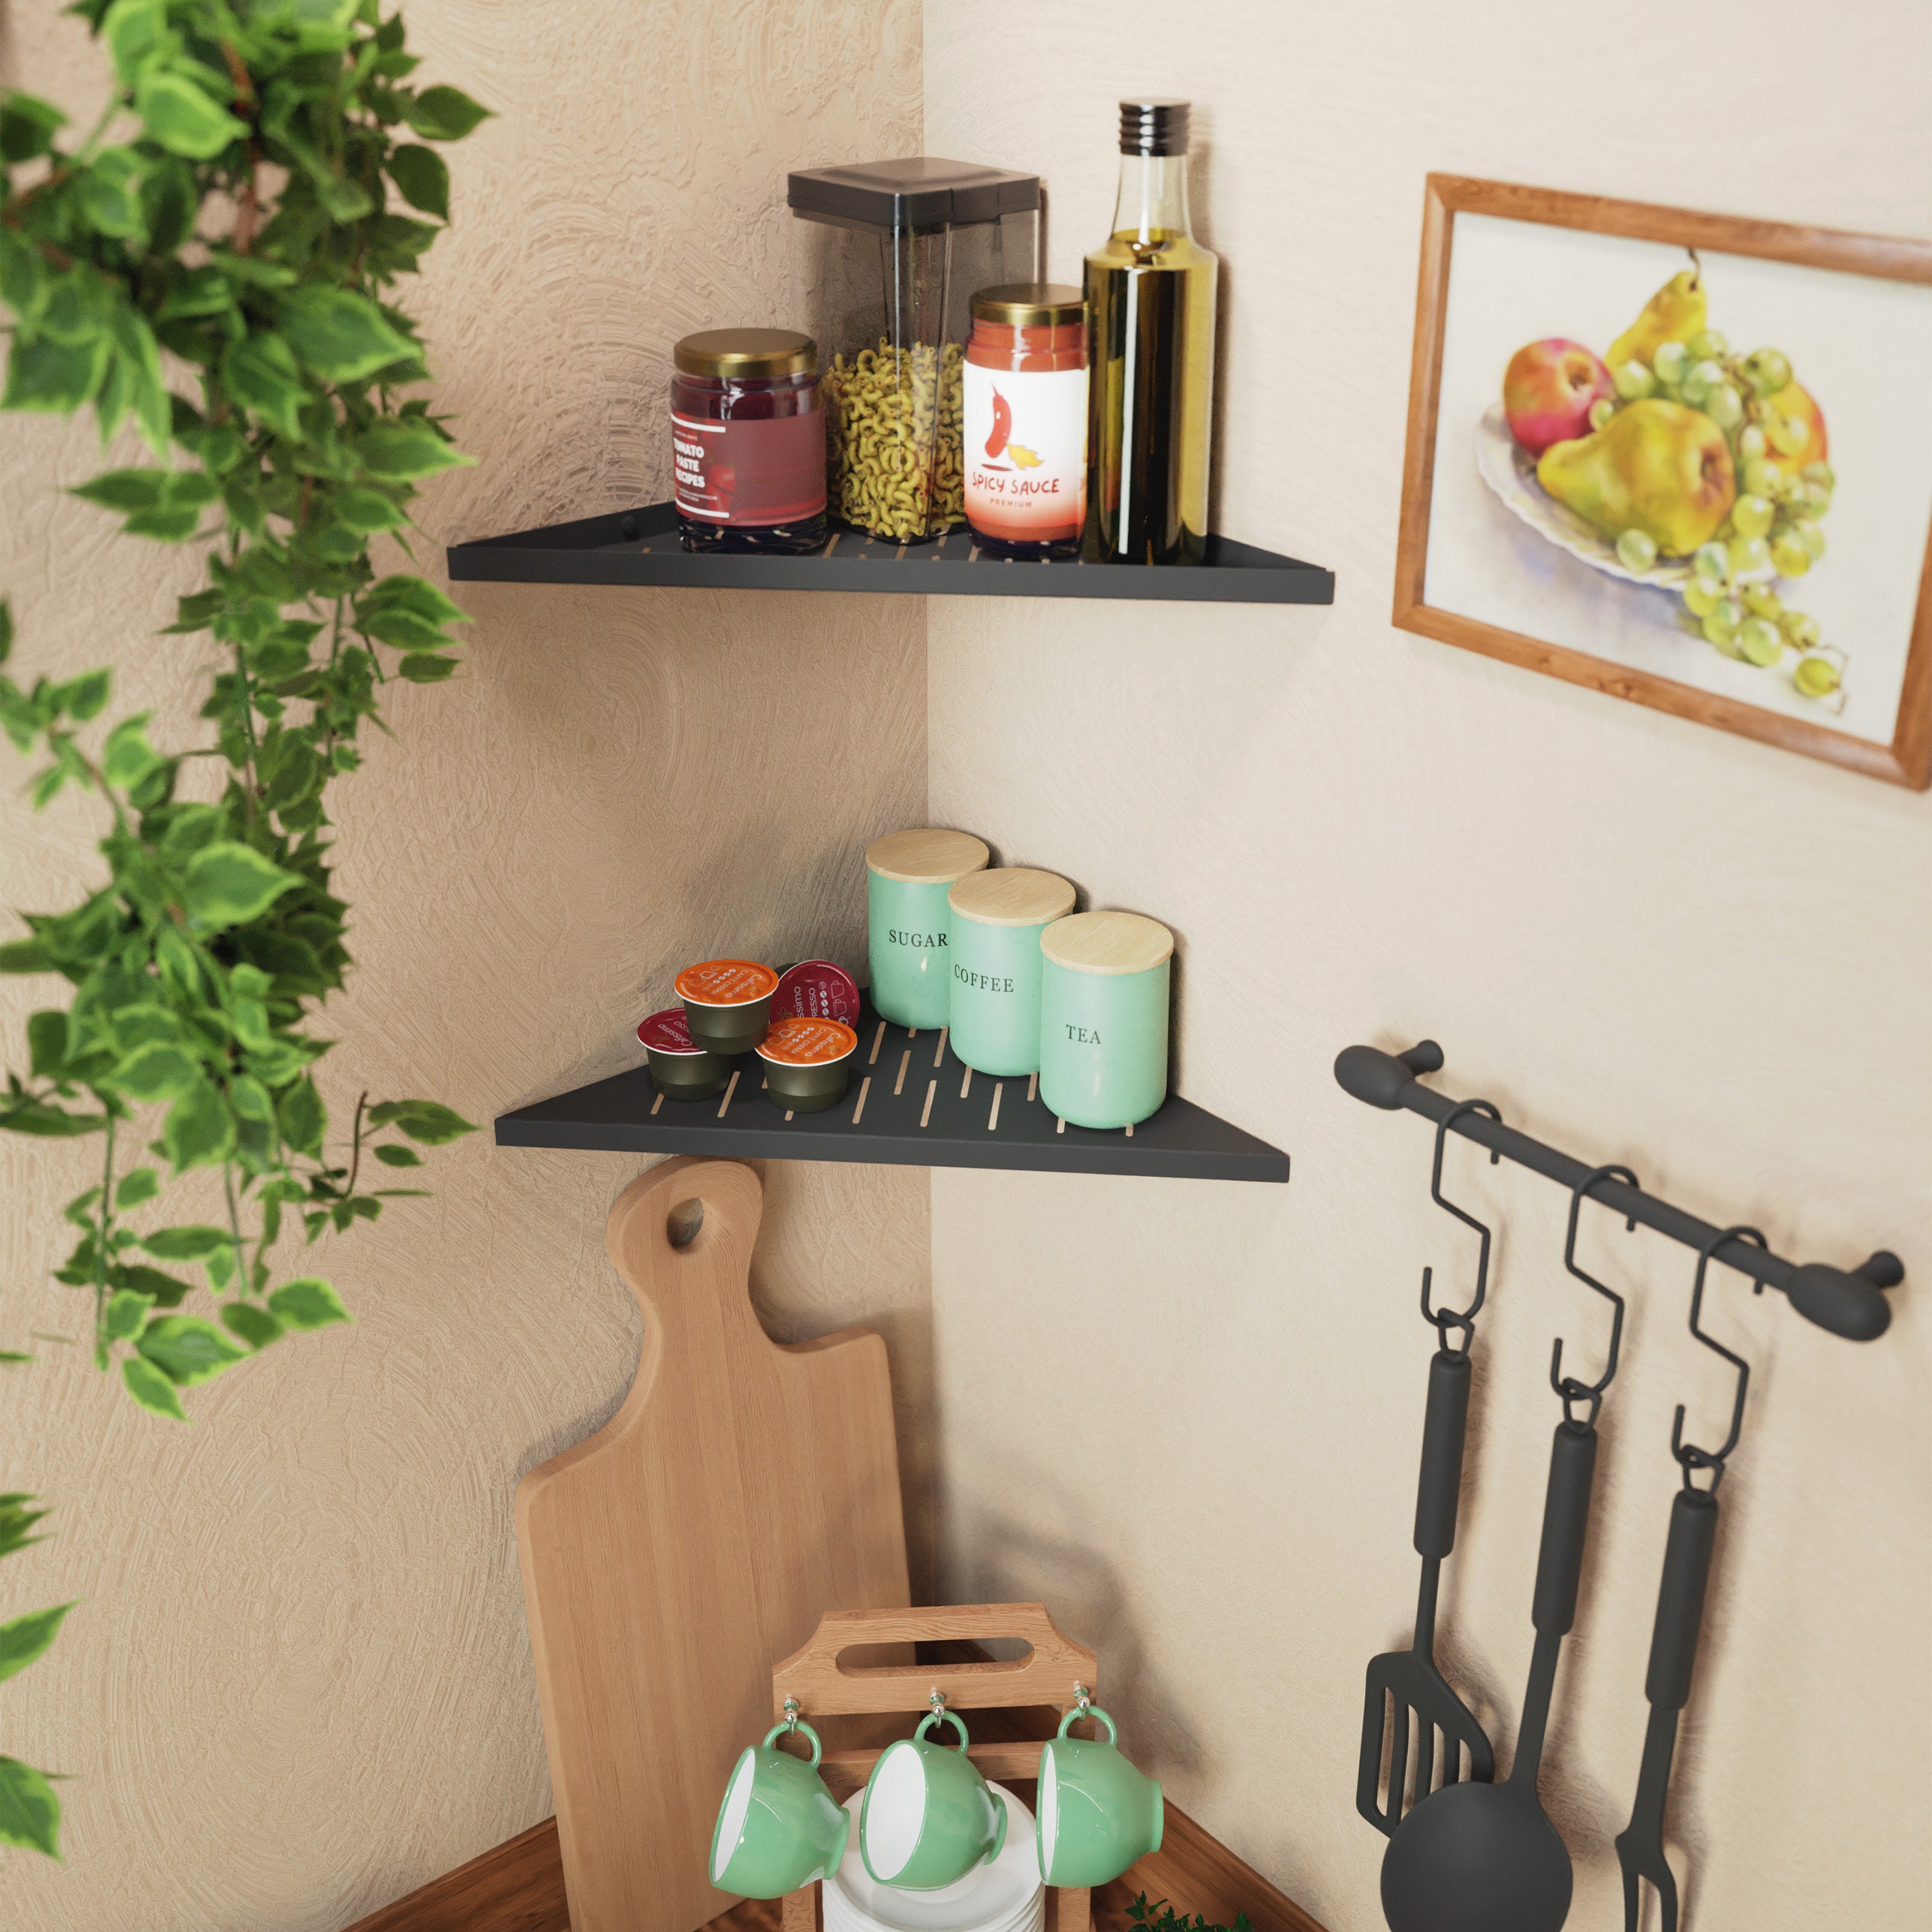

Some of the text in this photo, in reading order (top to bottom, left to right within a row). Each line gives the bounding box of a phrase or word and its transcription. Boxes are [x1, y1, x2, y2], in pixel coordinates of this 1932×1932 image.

[973, 472, 1060, 496] SPICY SAUCE
[990, 498, 1032, 508] PREMIUM
[889, 930, 948, 947] SUGAR
[954, 964, 1014, 993] COFFEE
[1066, 1024, 1101, 1044] TEA
